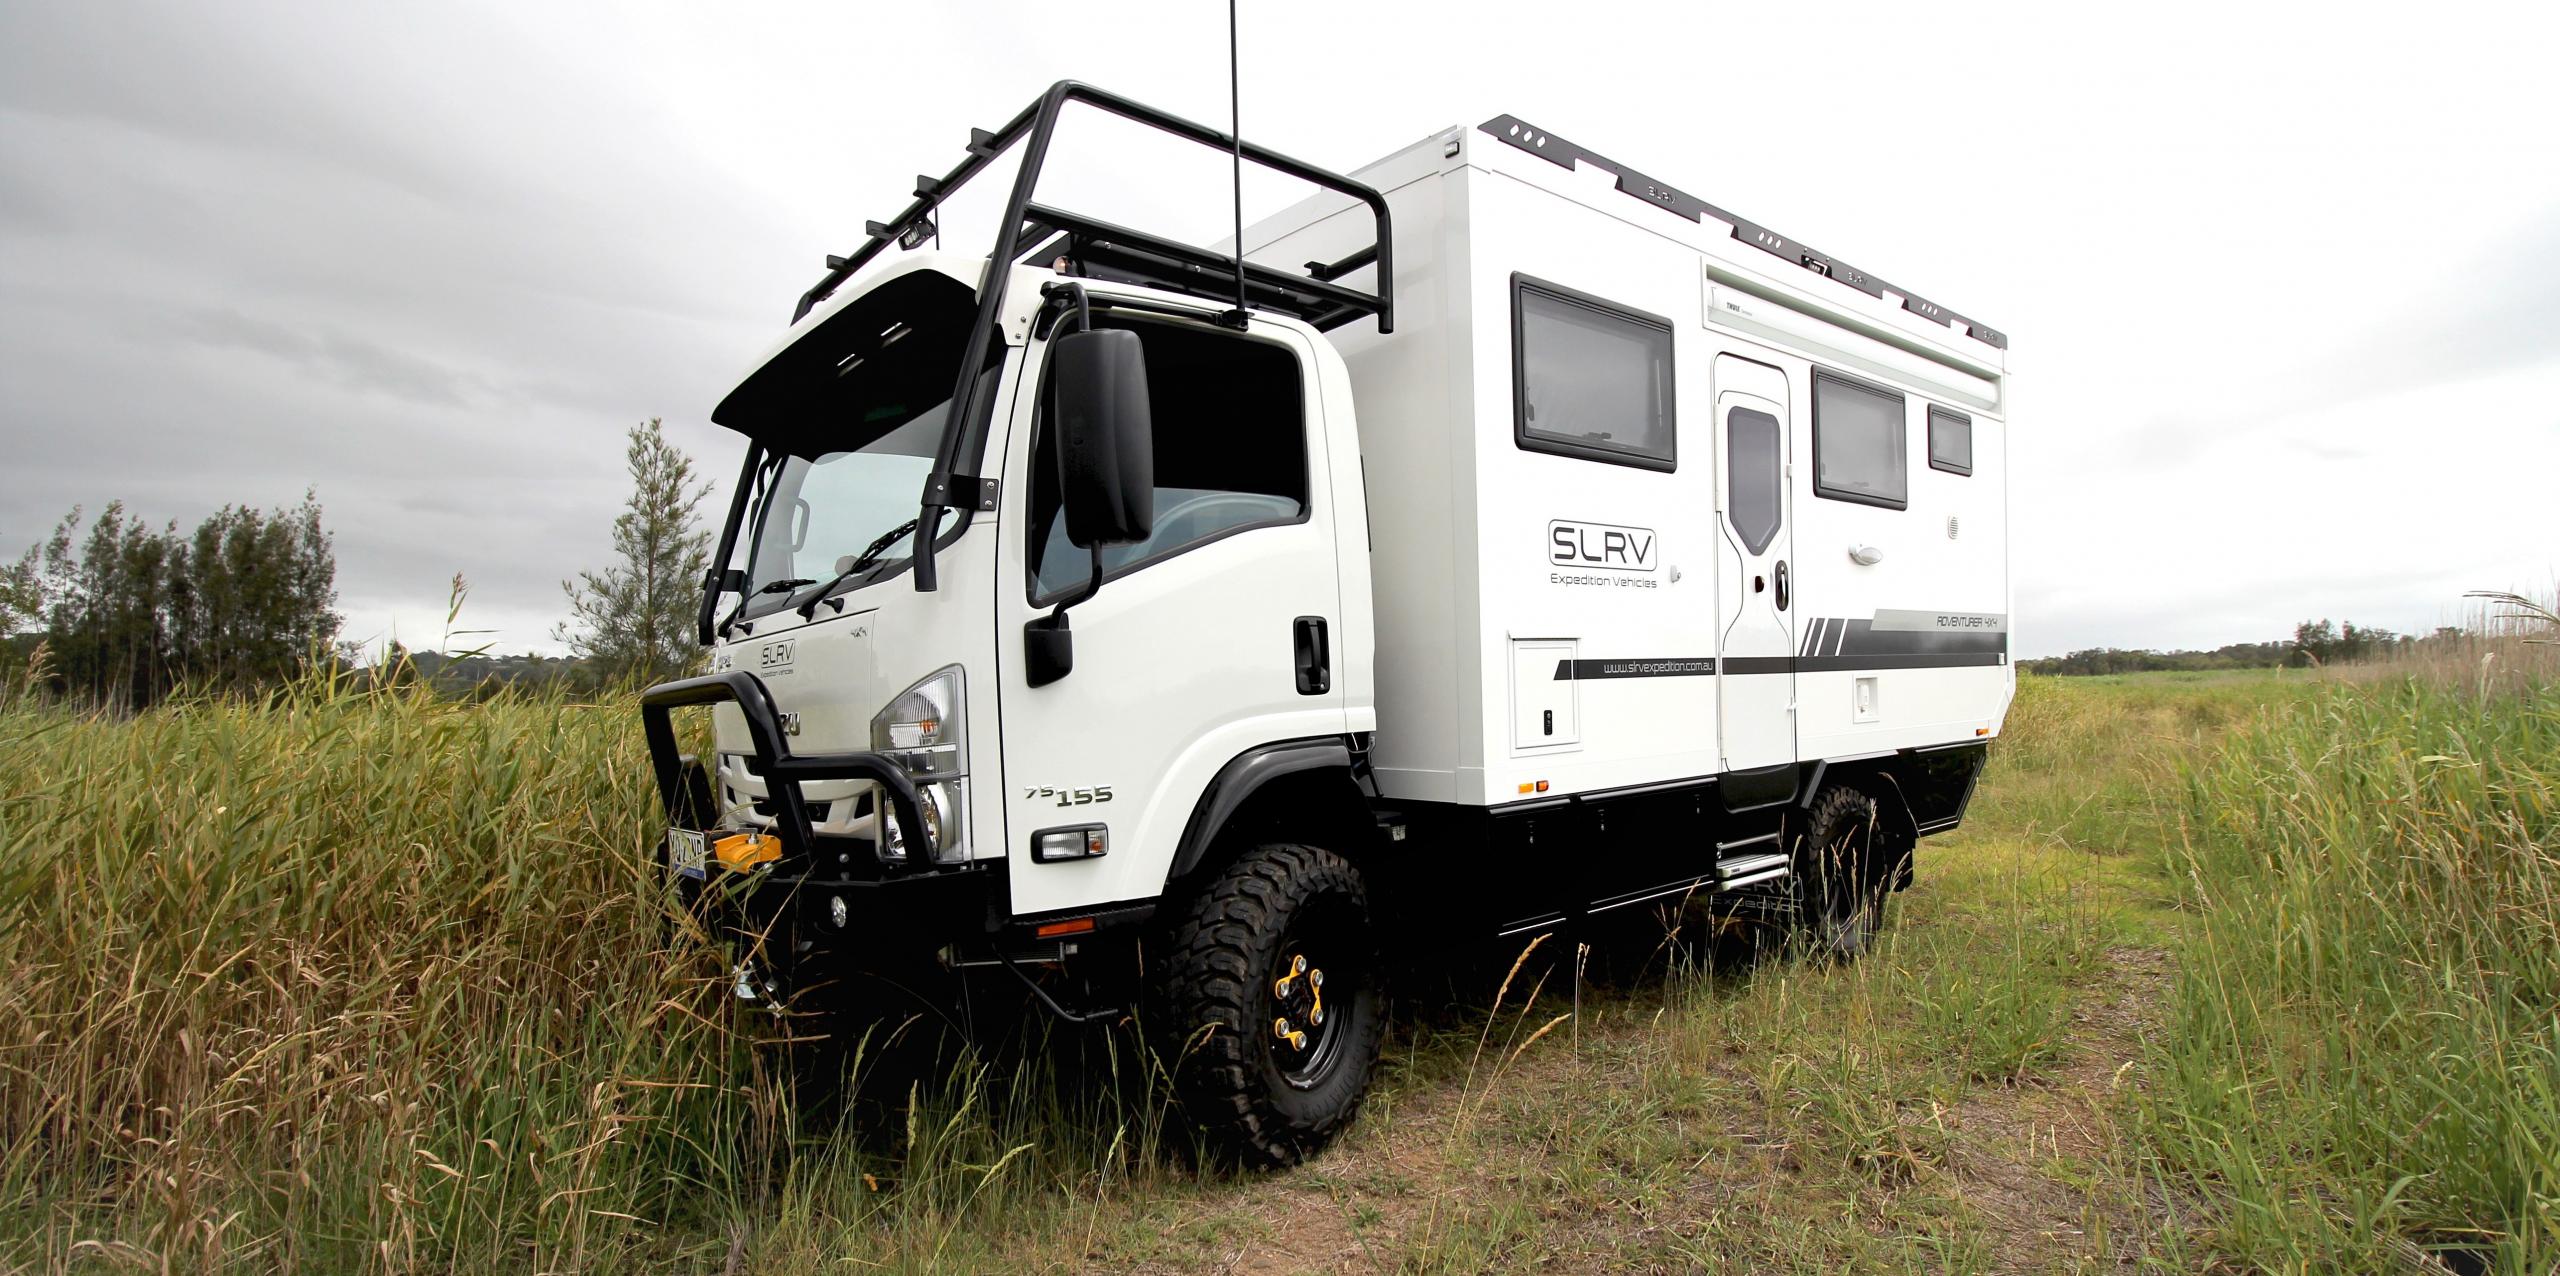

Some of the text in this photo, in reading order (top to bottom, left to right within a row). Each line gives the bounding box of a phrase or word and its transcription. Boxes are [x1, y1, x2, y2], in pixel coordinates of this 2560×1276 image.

[1552, 526, 1652, 565] SLRV
[1550, 573, 1657, 589] Expedition Vehicles
[1936, 615, 1983, 628] ADVENTURER
[762, 642, 794, 665] SLRV
[1603, 660, 1714, 676] www.slrvexpedition.com.au
[1023, 784, 1113, 807] 75 155
